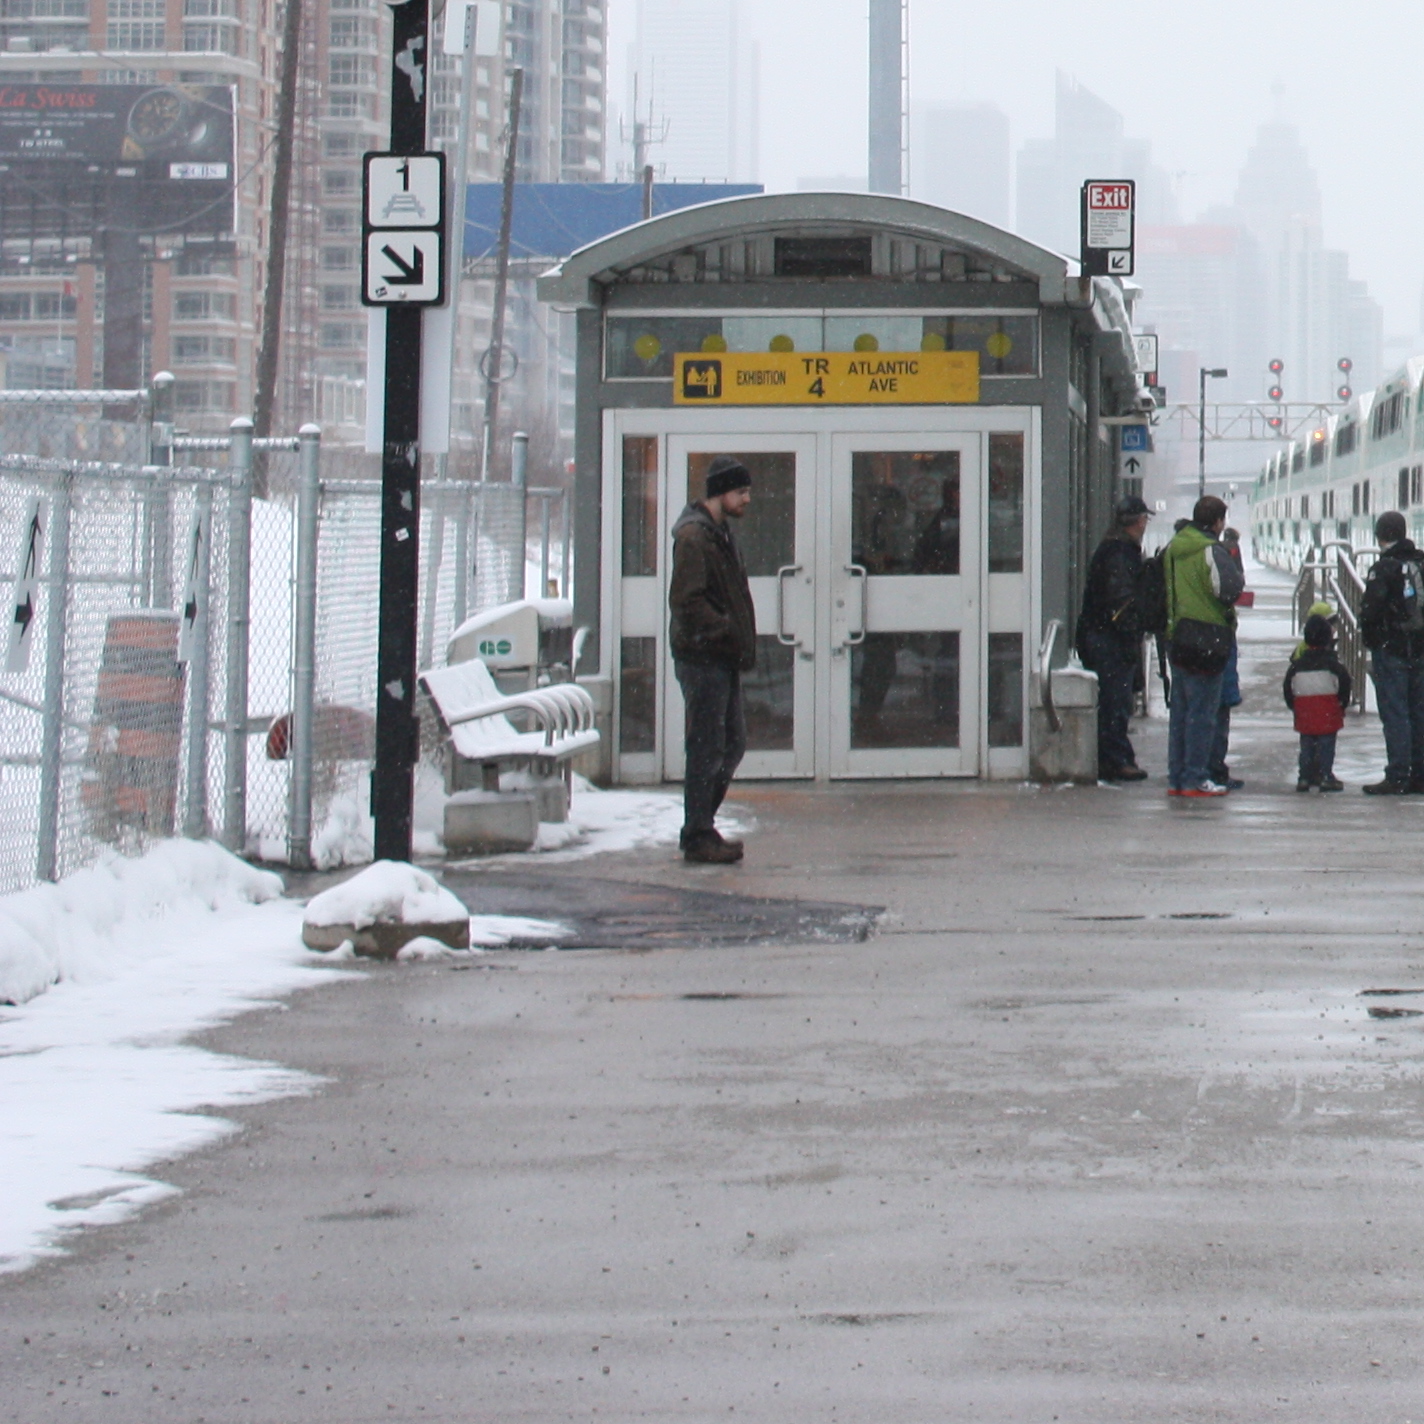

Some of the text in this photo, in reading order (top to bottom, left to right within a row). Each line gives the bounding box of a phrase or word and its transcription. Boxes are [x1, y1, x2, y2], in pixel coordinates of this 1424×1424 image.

[31, 87, 97, 109] Swiss
[396, 163, 410, 192] 1
[1091, 186, 1128, 208] Exit
[802, 358, 830, 375] TR
[847, 360, 919, 375] ATLANTIC
[736, 369, 787, 387] EXHIBITION
[808, 376, 826, 398] 4
[868, 378, 898, 393] AVE
